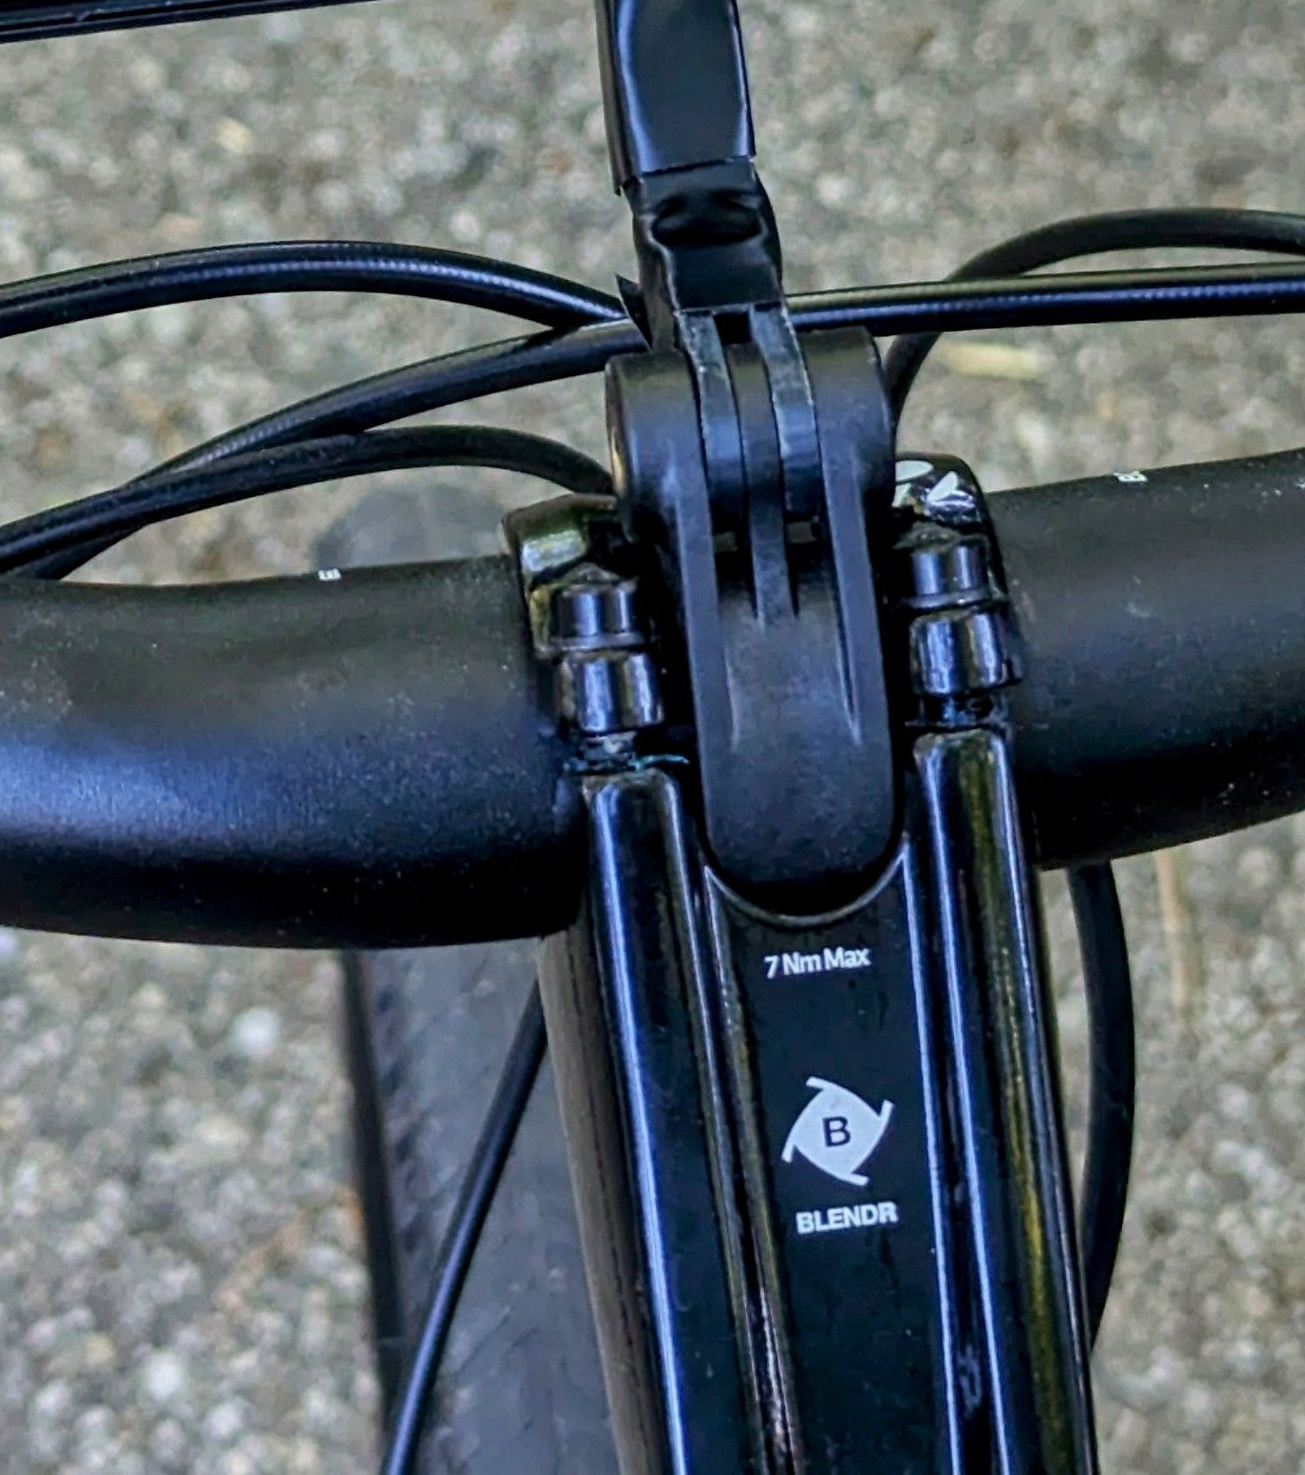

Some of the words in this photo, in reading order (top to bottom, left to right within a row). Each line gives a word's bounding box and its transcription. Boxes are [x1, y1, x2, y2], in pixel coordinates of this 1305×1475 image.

[764, 954, 779, 978] 7
[782, 952, 822, 975] Nm
[823, 946, 872, 971] Max
[822, 1116, 851, 1148] B
[796, 1201, 899, 1235] BLENDR
